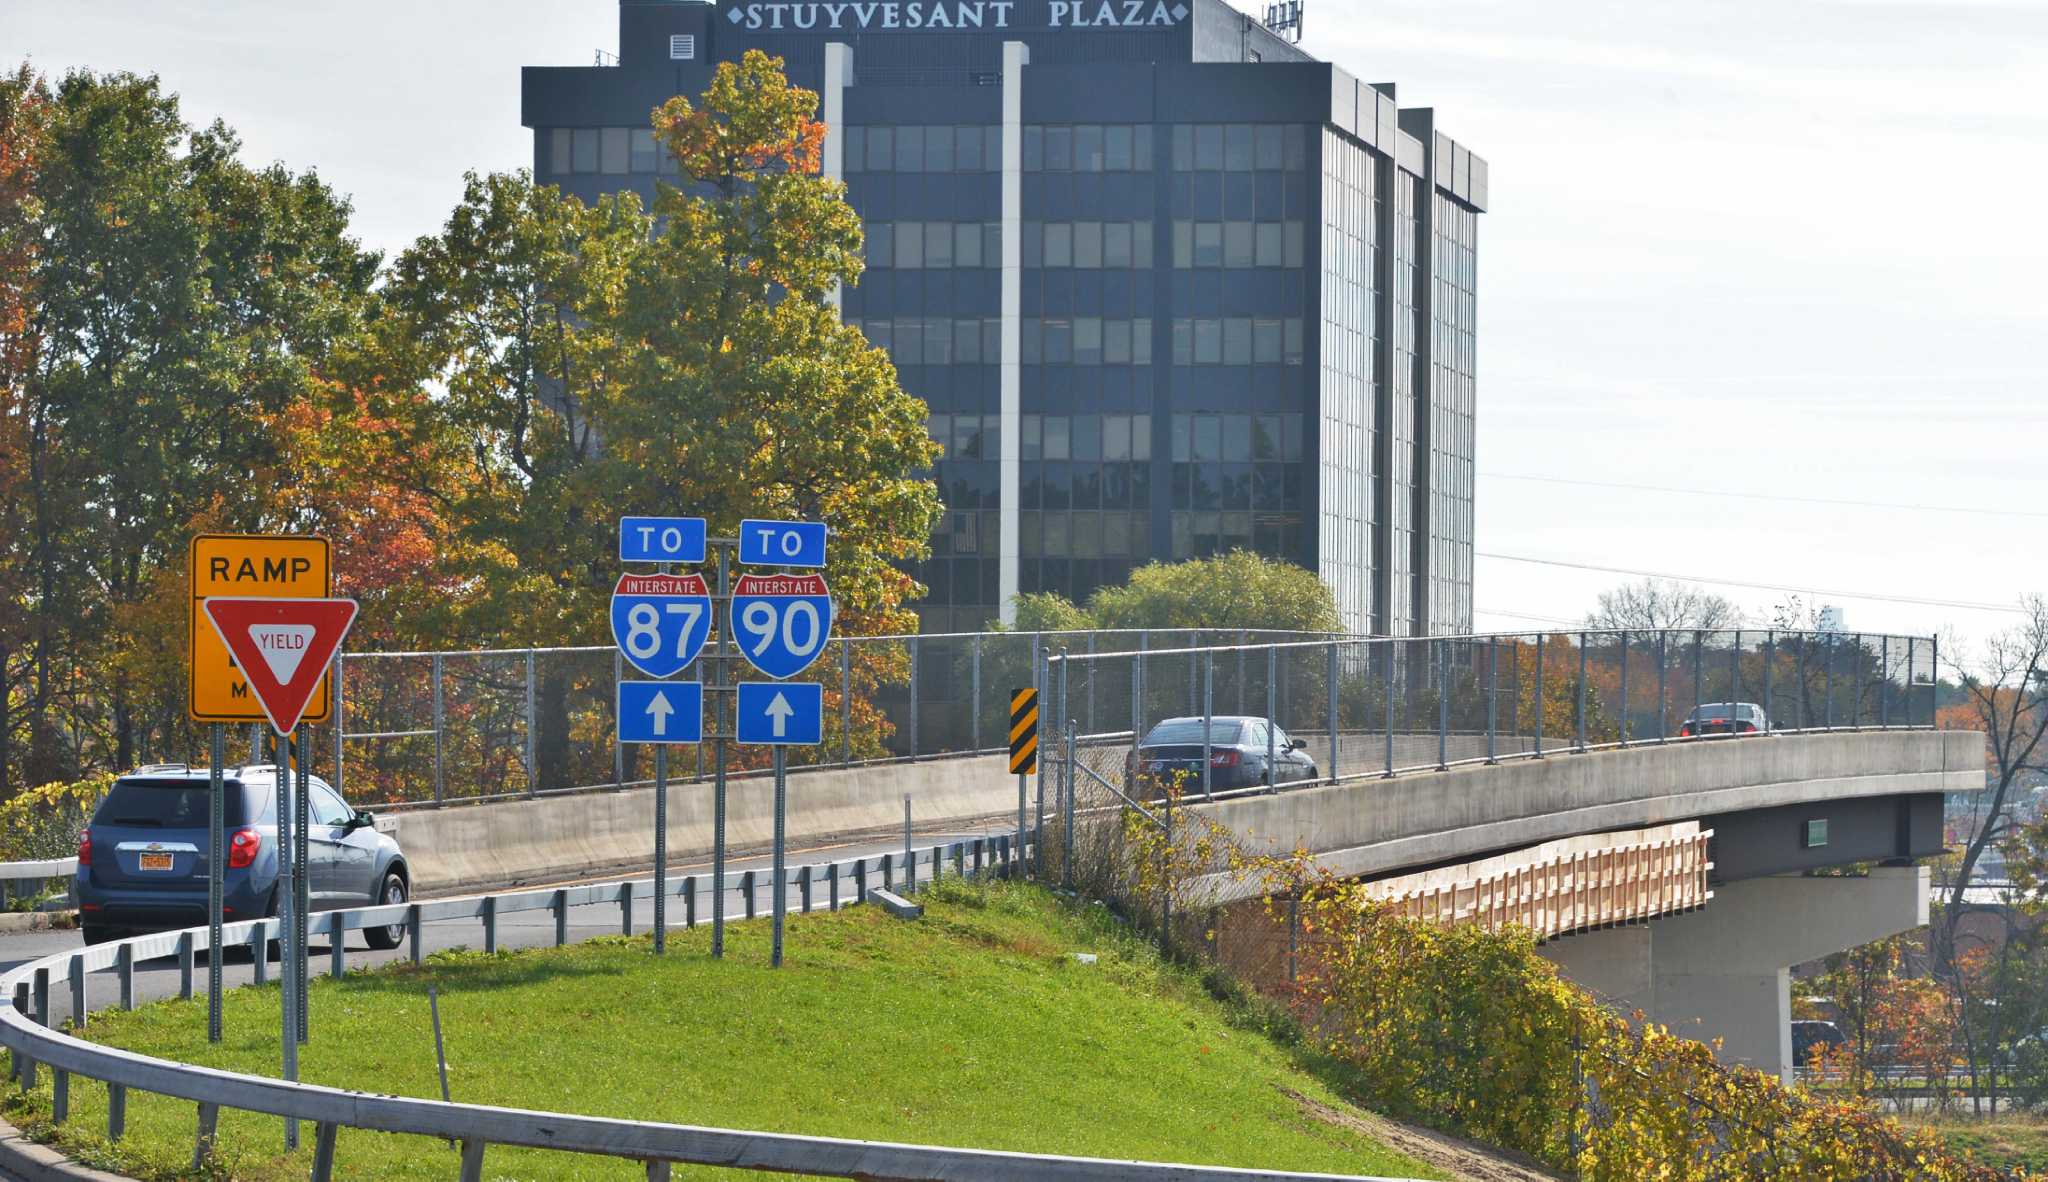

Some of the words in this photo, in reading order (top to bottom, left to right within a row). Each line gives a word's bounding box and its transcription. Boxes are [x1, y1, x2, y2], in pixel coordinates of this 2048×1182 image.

[745, 1, 1014, 29] STUYVESANT
[1048, 0, 1175, 26] PLAZA
[637, 527, 682, 553] TO
[757, 530, 802, 556] TO
[210, 557, 311, 582] RAMP
[626, 581, 697, 593] INTERSTATE
[745, 581, 817, 594] INTERSTATE
[626, 603, 703, 659] 87
[742, 600, 820, 657] 90
[260, 634, 304, 650] YIELD
